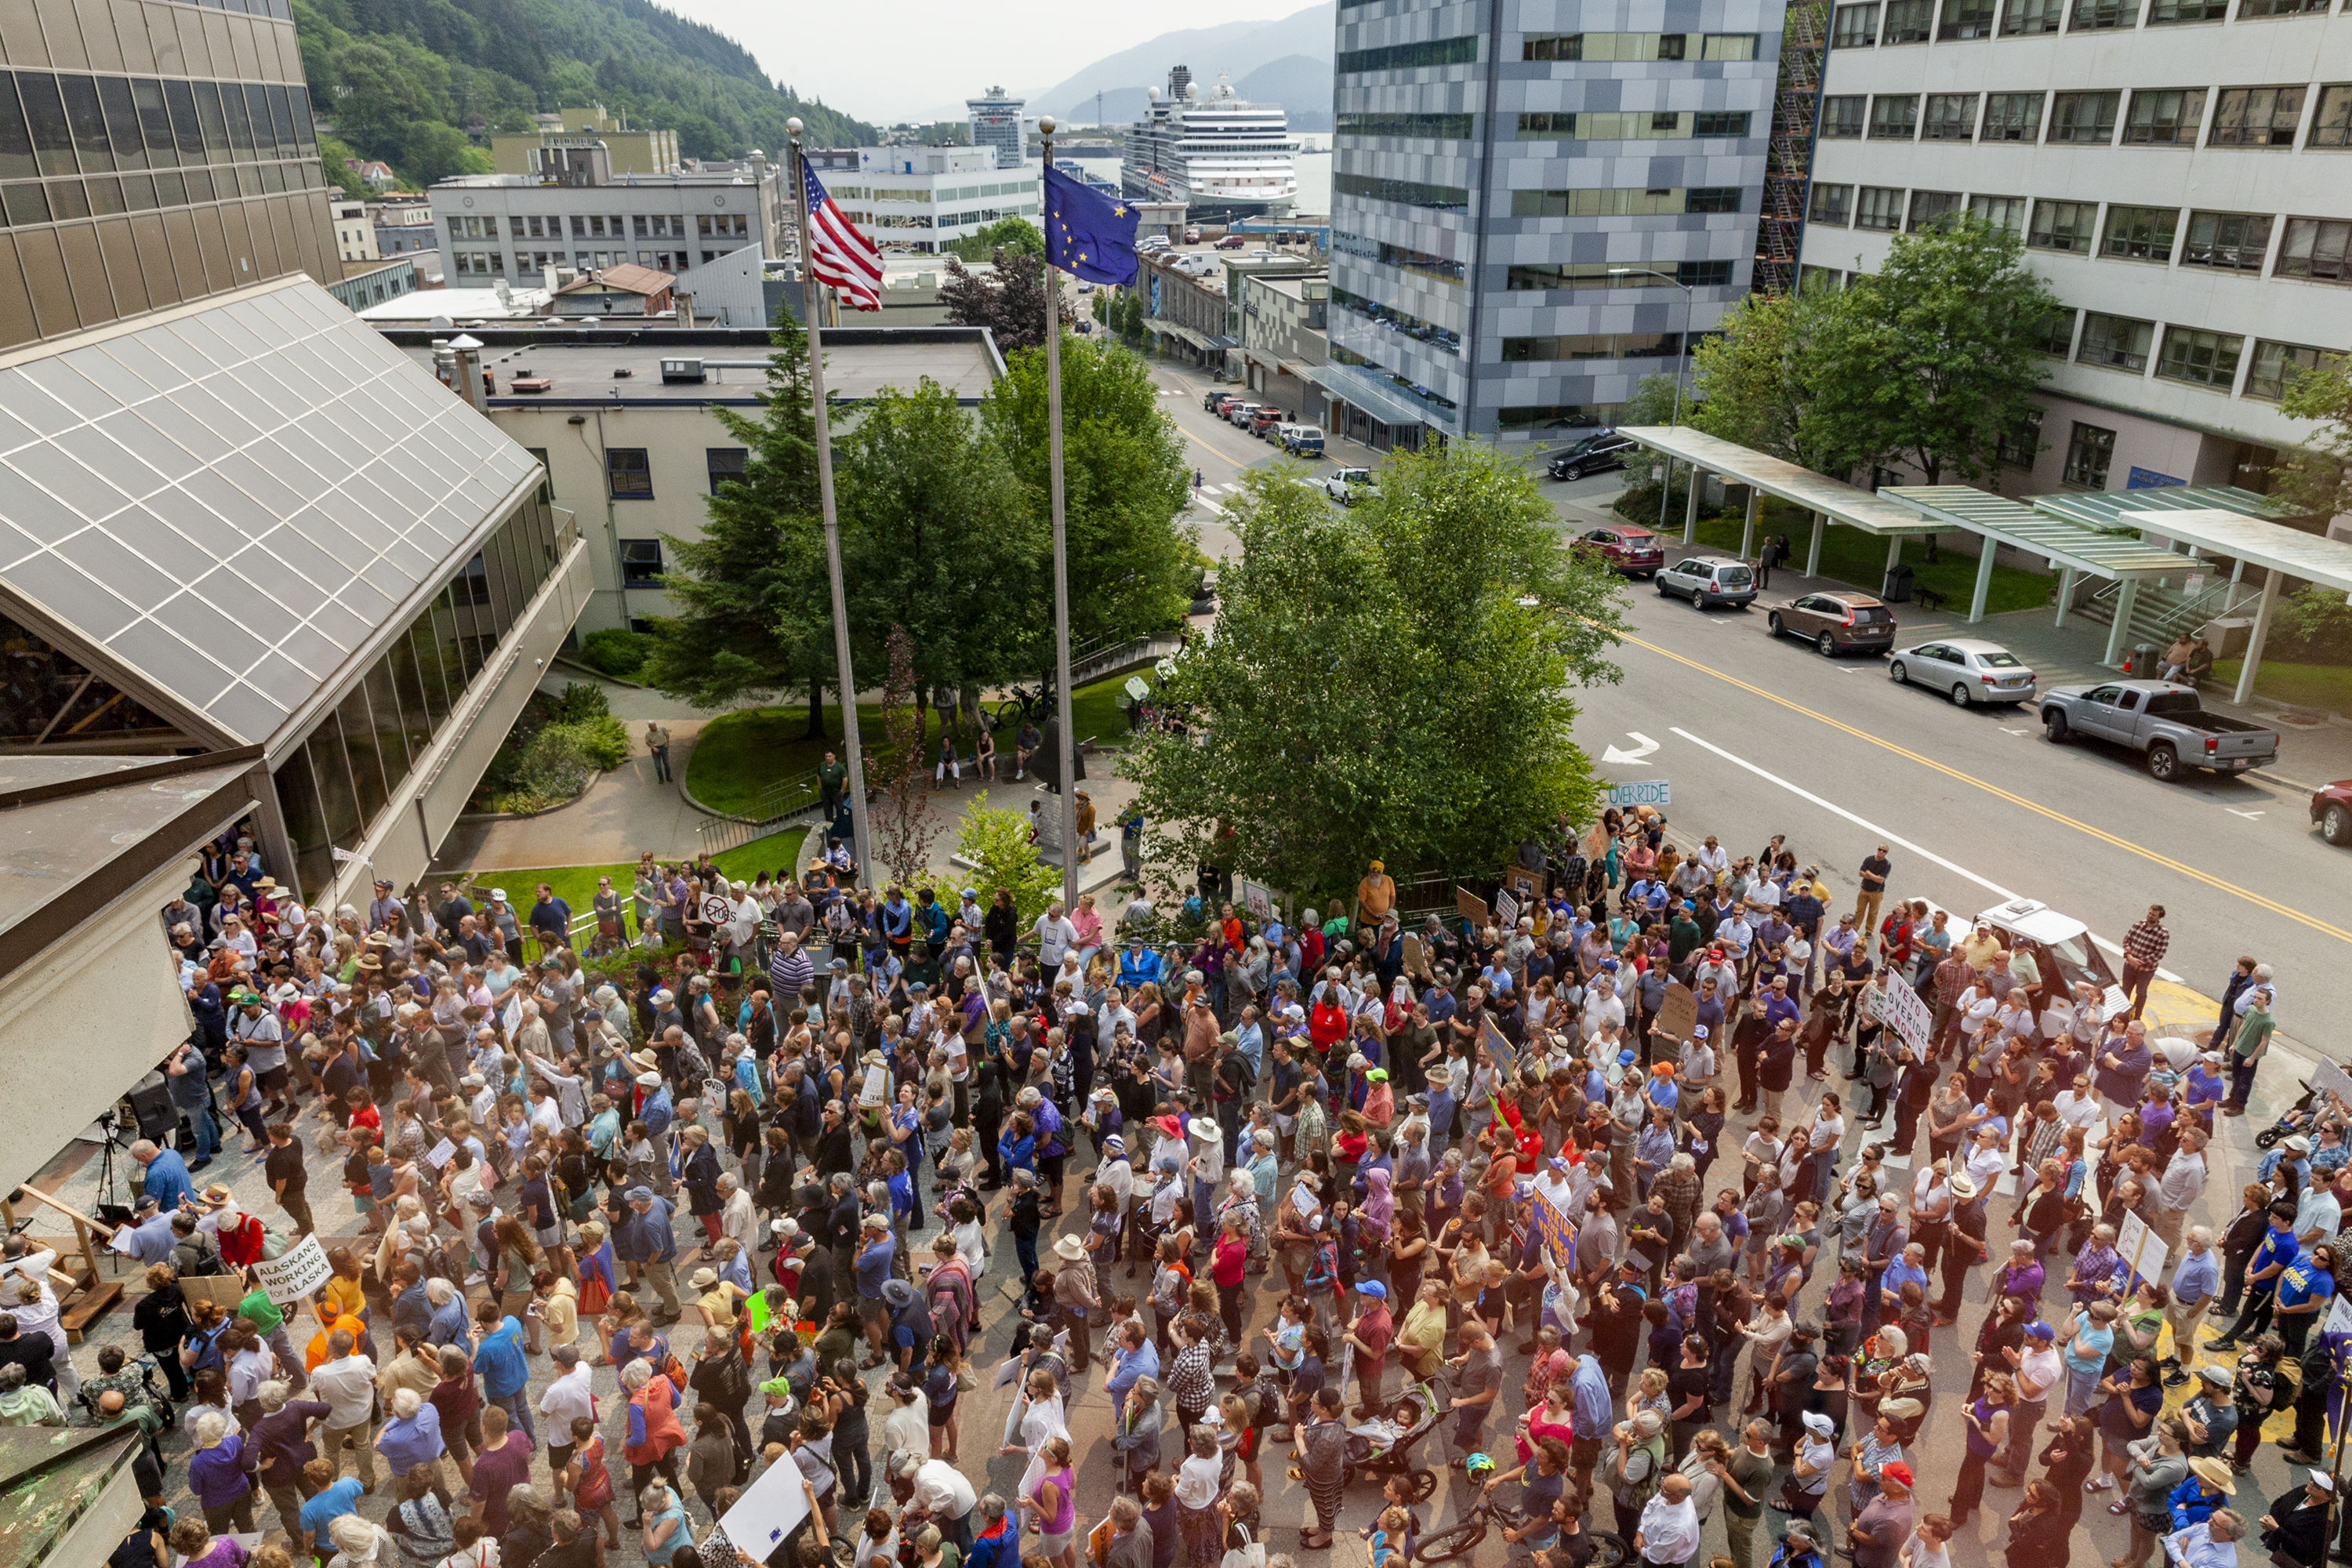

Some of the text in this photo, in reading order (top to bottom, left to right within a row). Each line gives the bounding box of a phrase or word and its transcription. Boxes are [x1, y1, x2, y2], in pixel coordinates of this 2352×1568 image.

[1609, 784, 1668, 804] OVERRIDE
[701, 902, 736, 923] VETOES
[1898, 982, 1921, 1017] VETO
[1888, 993, 1927, 1044] OVERIDE
[1894, 1014, 1916, 1047] NOW!
[1534, 1189, 1574, 1243] OVERRIDE
[1547, 1217, 1559, 1237] THE
[260, 1240, 317, 1276] ALASKANS
[1537, 1217, 1570, 1265] VETOES
[264, 1252, 321, 1287] WORKING
[270, 1263, 328, 1298] for ALASKA
[2337, 1301, 2352, 1324] INNO
